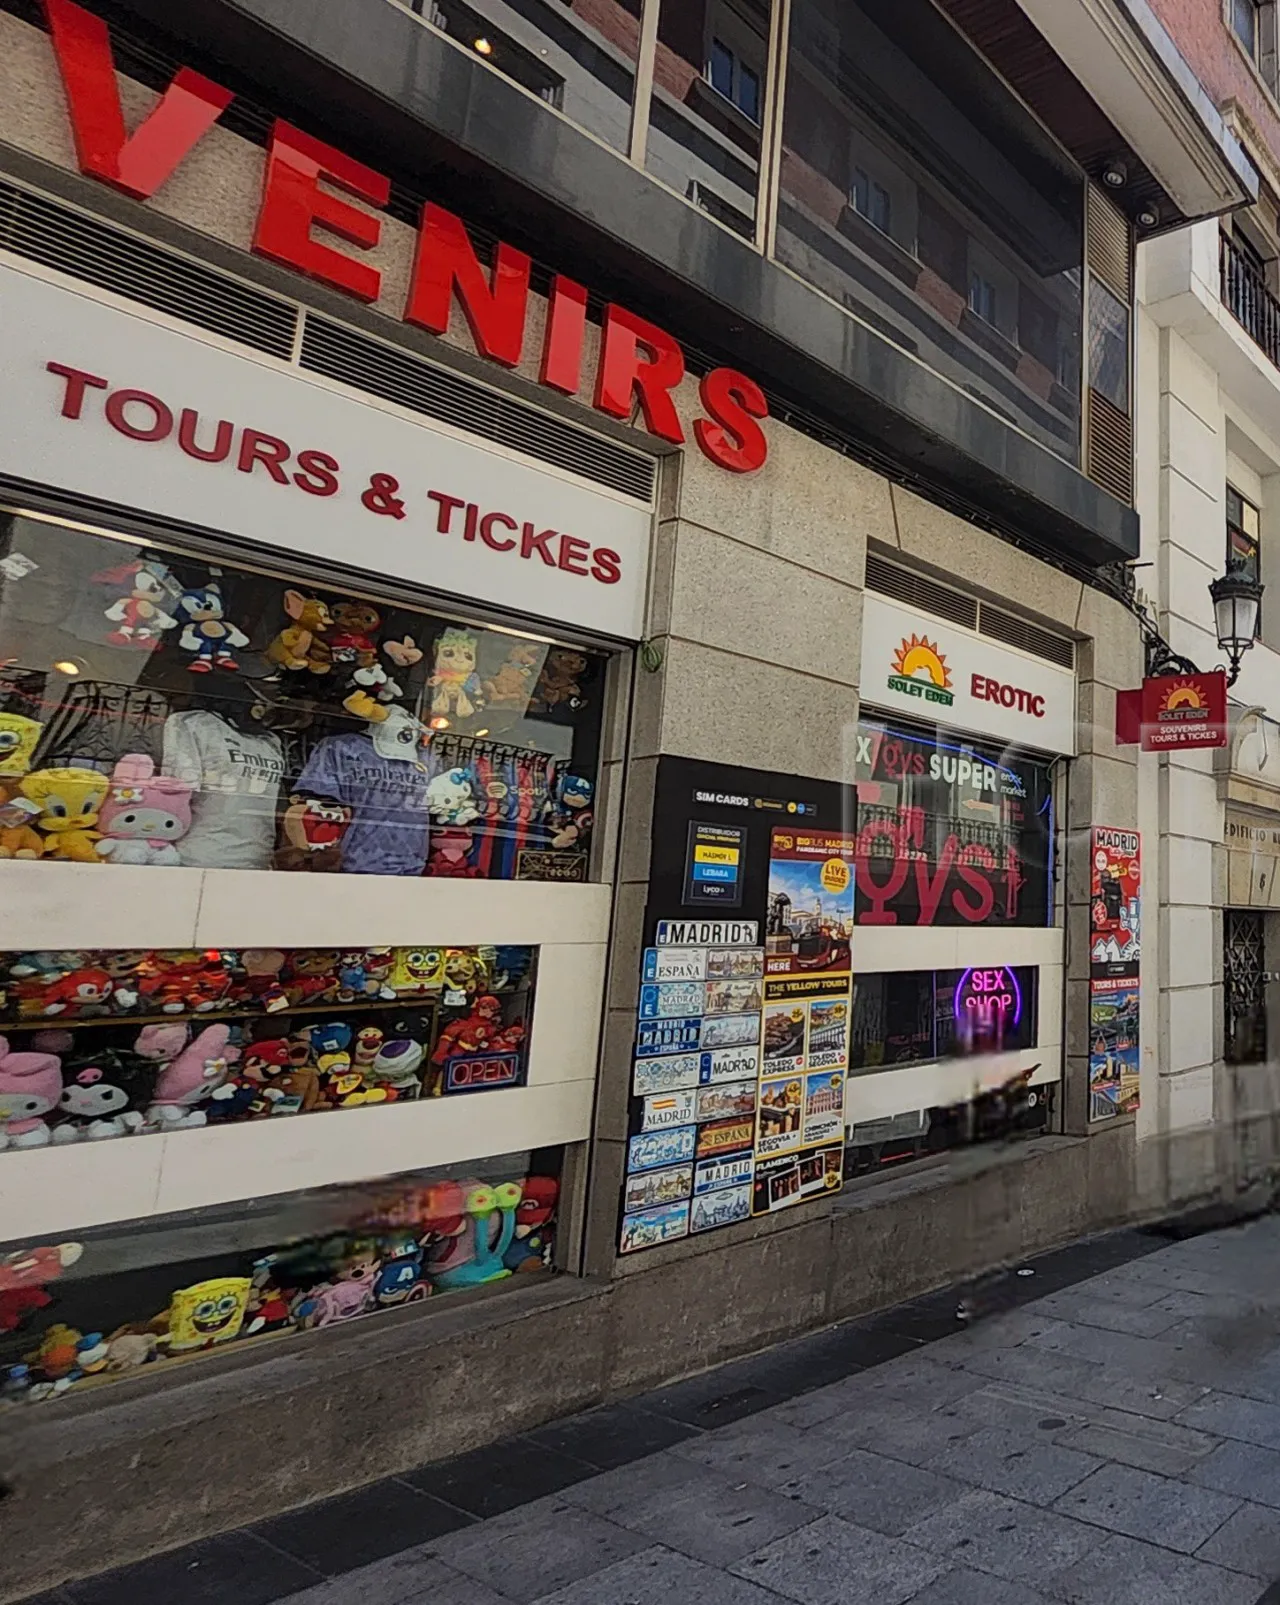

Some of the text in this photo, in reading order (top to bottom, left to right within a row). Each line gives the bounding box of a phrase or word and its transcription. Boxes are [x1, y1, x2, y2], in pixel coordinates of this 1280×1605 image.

[46, 0, 769, 474] VENIRS
[46, 360, 623, 586] TOURS & TICKES
[887, 677, 954, 707] SOLET EDEN
[970, 672, 1046, 718] EROTIC
[1157, 711, 1184, 721] SOLET
[1160, 723, 1207, 735] SOUVENIRS
[1150, 734, 1178, 743] TOURS
[1187, 731, 1217, 740] TICKES
[929, 753, 997, 793] SUPER
[696, 791, 715, 802] SIM
[716, 795, 749, 806] CARDS
[1000, 785, 1027, 798] market
[1224, 821, 1267, 842] EDIFICIO
[1096, 832, 1138, 851] MADRID
[825, 864, 847, 877] LIVE
[670, 924, 741, 943] MADRID
[647, 963, 700, 978] E ESPAÑA
[767, 961, 791, 972] HERE
[769, 979, 847, 992] THE YELLOW TOURS
[971, 970, 1005, 992] SEX
[645, 1004, 653, 1015] E
[642, 1028, 698, 1046] MADRID
[763, 1058, 793, 1068] TOLEDO
[809, 1052, 836, 1061] TOLEDO
[452, 1058, 514, 1084] OPEN
[702, 1071, 709, 1080] E
[762, 1064, 795, 1076] EXPRESS
[646, 1108, 691, 1127] MADRID
[758, 1134, 791, 1147] SEGOVIA
[756, 1154, 799, 1171] FLAMENCO
[705, 1161, 751, 1182] MADRID
